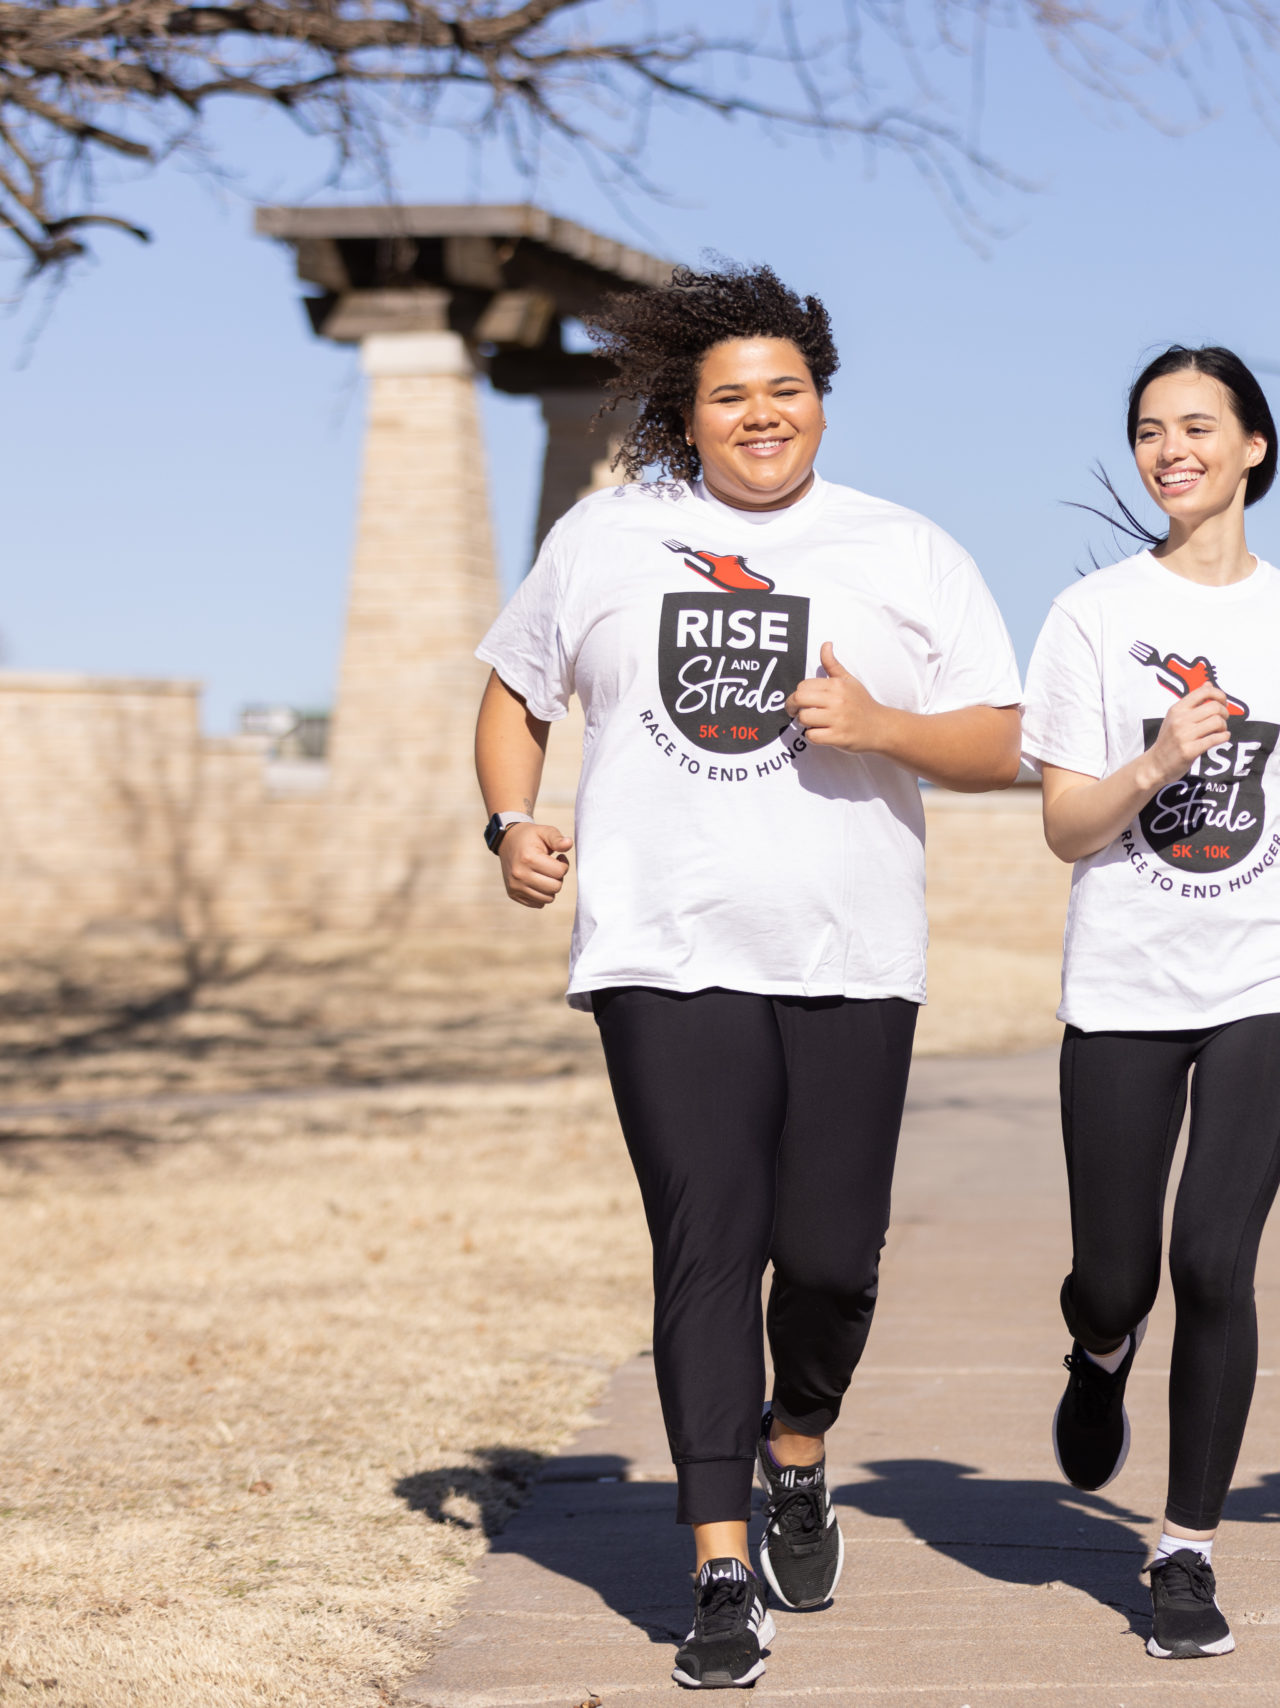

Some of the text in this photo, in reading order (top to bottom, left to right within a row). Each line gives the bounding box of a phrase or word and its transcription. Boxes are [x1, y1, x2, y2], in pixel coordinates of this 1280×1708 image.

[676, 609, 789, 652] RISE
[675, 655, 786, 714] Stride
[731, 660, 760, 671] AND
[639, 709, 807, 781] RACE TO END HUNG
[699, 725, 759, 741] 5K 10K
[1150, 780, 1257, 835] Stride
[1205, 782, 1227, 793] AND
[1121, 829, 1148, 874] RACE
[1150, 871, 1174, 891] TO
[1181, 884, 1221, 899] END
[1172, 844, 1230, 859] 5K 10K
